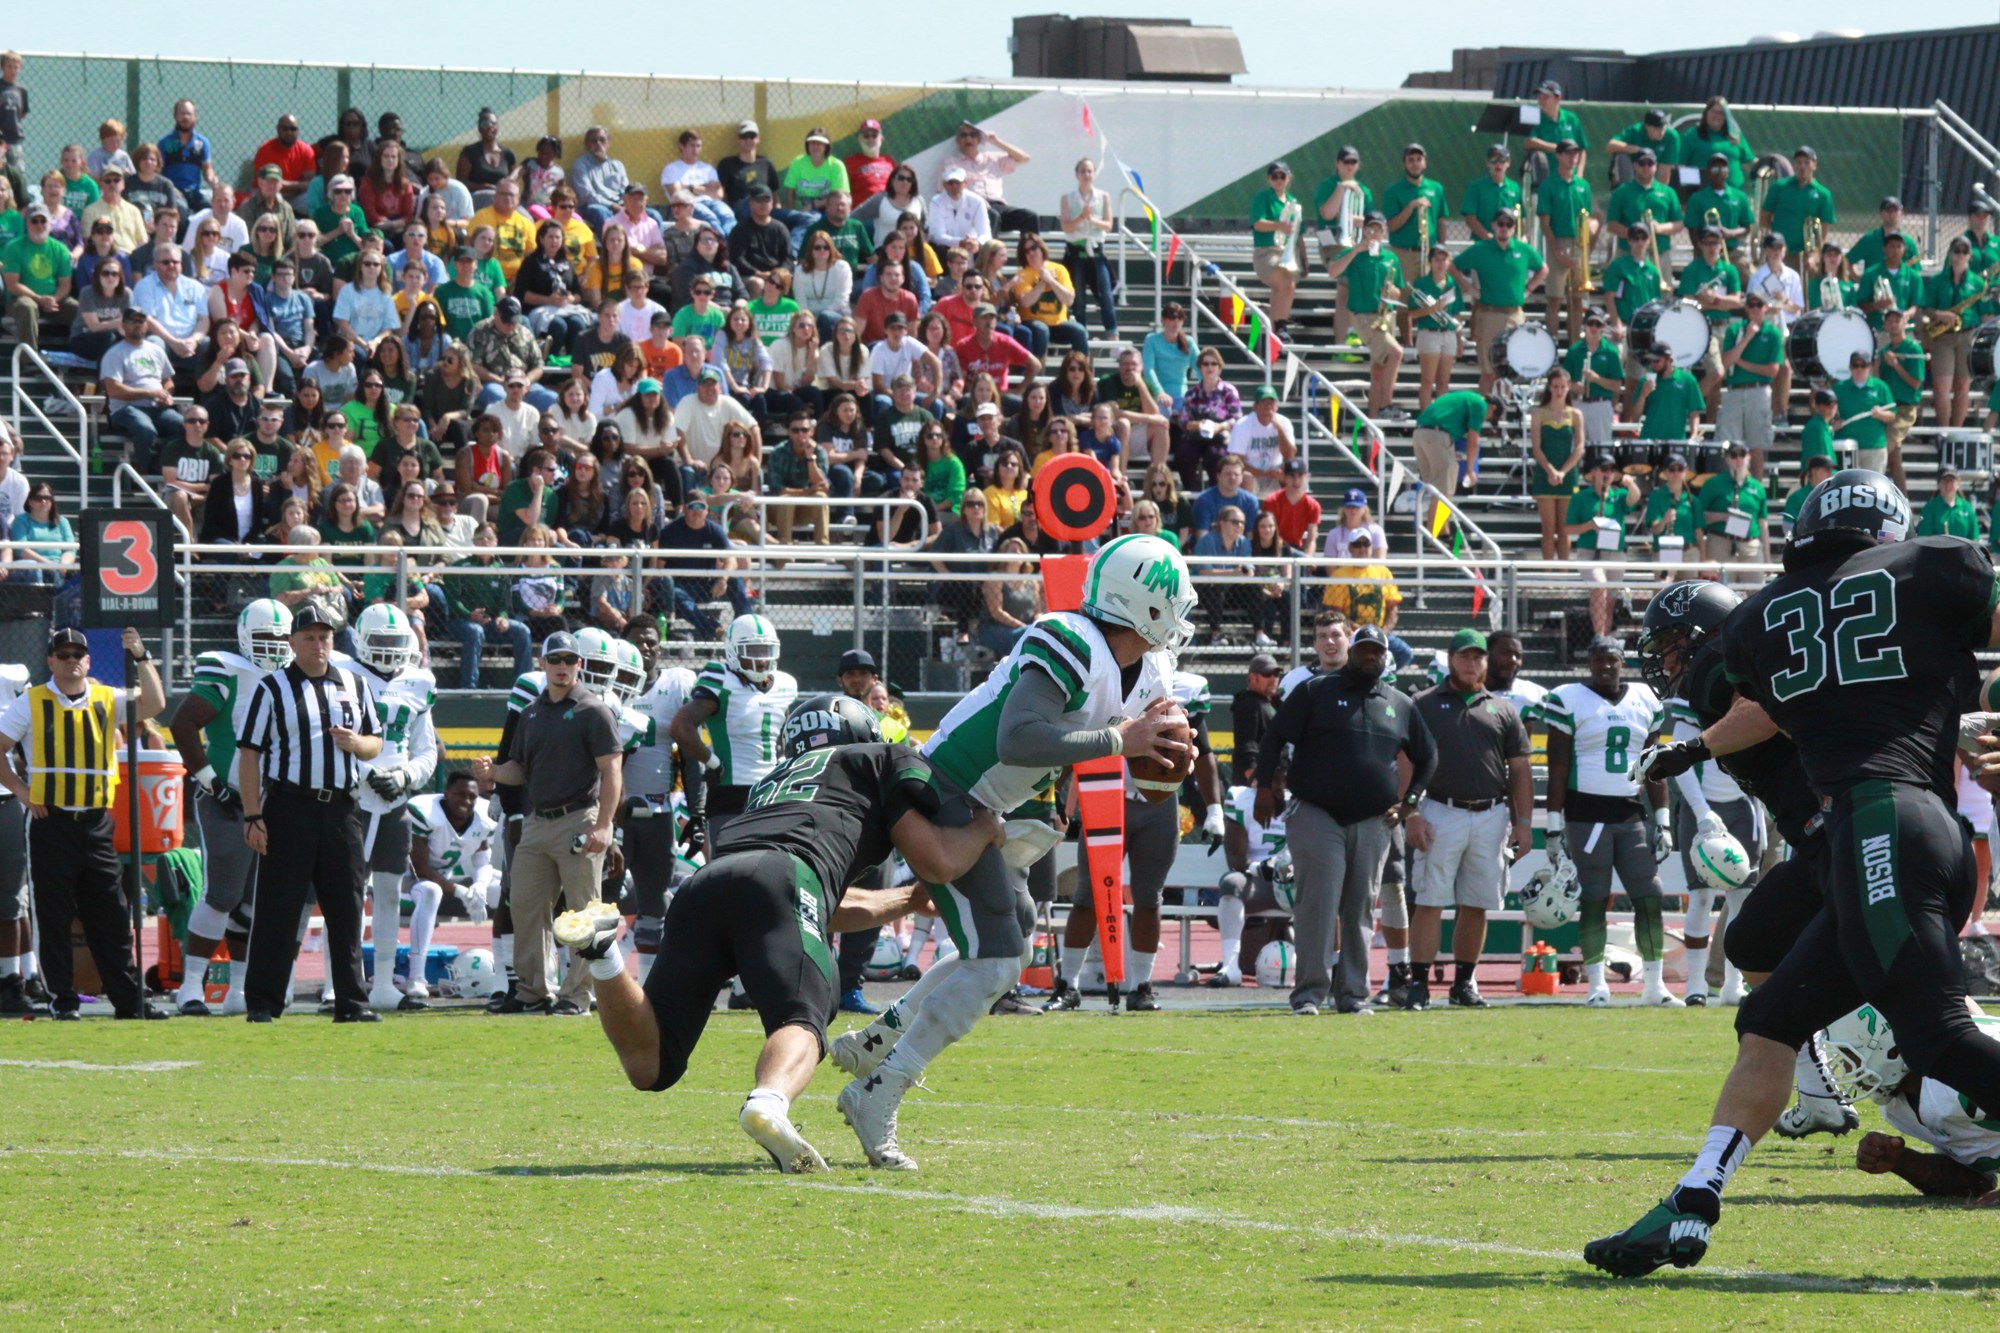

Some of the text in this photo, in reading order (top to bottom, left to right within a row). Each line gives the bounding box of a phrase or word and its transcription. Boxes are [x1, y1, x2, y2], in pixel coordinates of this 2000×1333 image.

[177, 457, 210, 482] OBU
[99, 520, 159, 596] 3
[100, 597, 159, 611] DIAL-A-DOWN
[1763, 568, 1909, 702] 32
[344, 712, 353, 728] L
[761, 711, 772, 761] 1
[795, 740, 807, 754] 52
[1605, 726, 1631, 773] 8
[156, 780, 176, 806] G
[1861, 833, 1897, 906] BISON
[1103, 876, 1117, 943] Gilman
[471, 955, 482, 970] 2
